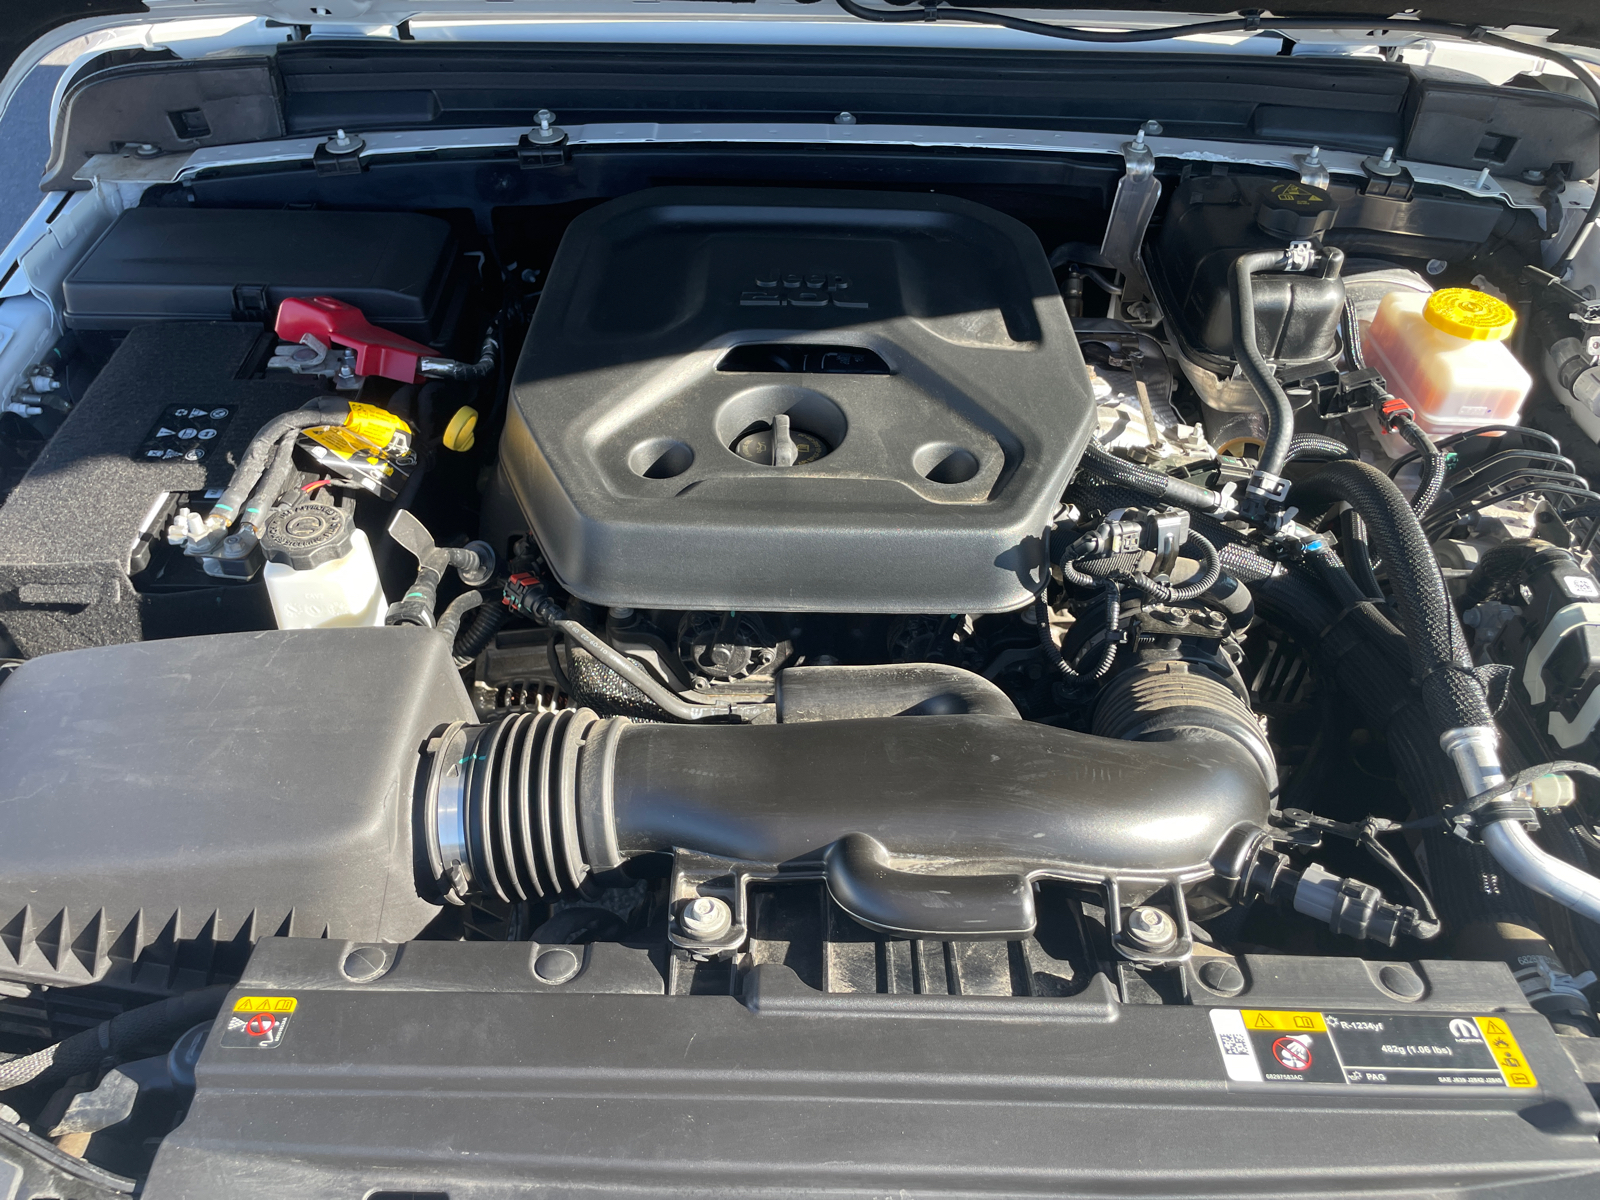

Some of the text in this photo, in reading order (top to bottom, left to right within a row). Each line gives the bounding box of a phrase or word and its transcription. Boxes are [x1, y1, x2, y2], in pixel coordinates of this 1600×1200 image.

[755, 270, 850, 291] Jeep
[739, 290, 869, 309] 2.0L
[1340, 1021, 1385, 1032] R-1234yf
[1381, 1044, 1453, 1056] 482g (1.06 lbs)
[1366, 1073, 1387, 1082] PAG
